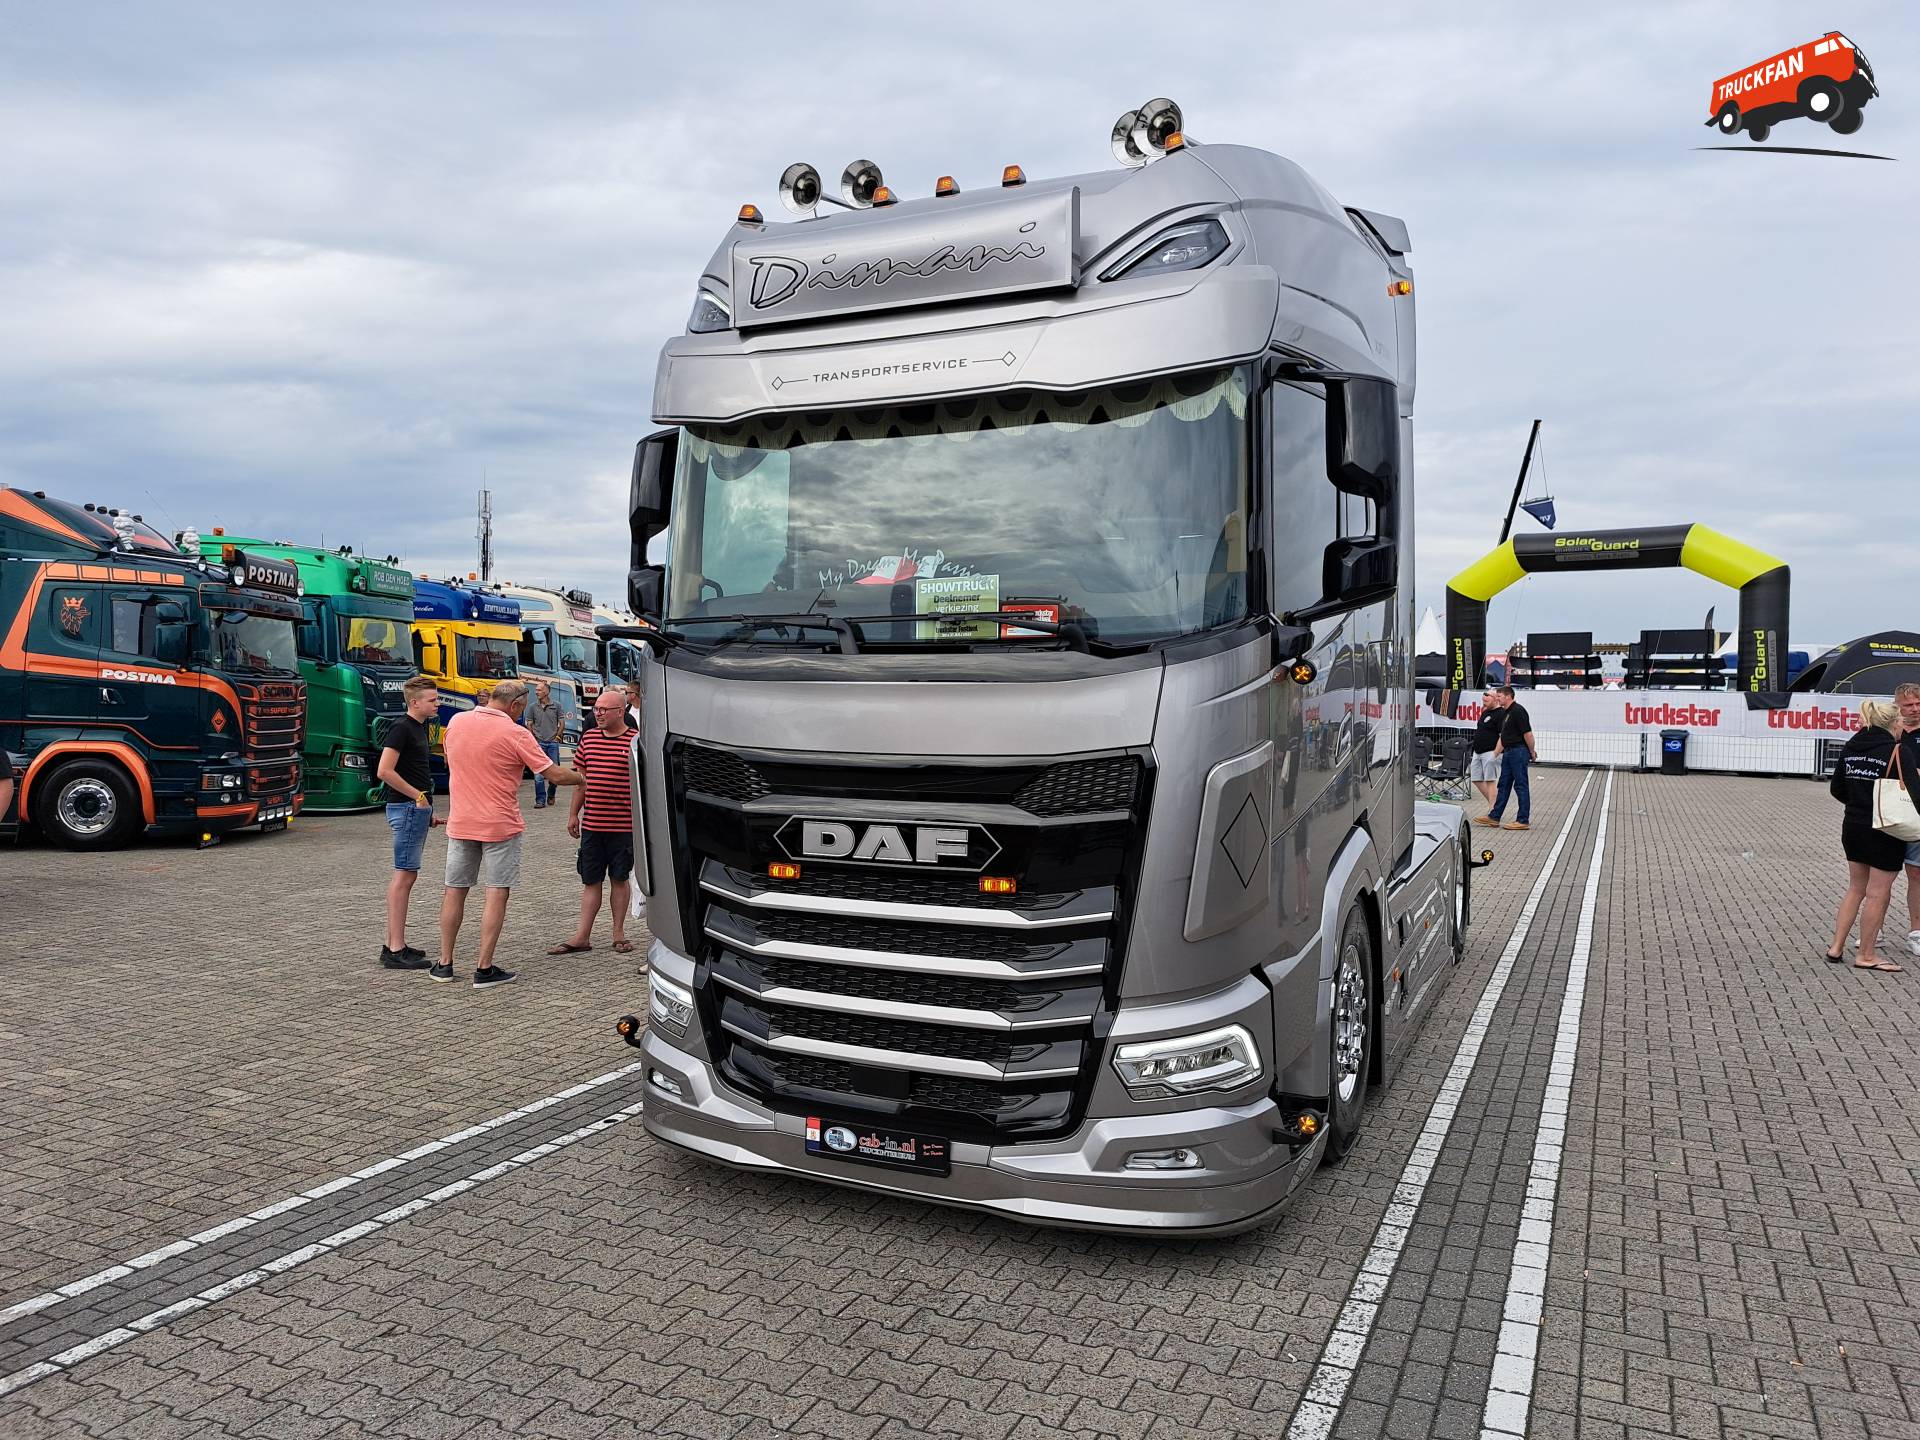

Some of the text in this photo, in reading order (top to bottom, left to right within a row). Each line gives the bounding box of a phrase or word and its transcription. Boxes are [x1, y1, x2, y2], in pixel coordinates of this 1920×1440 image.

[749, 222, 1045, 309] Dimani
[812, 358, 968, 383] TRANSPORTSERVICE
[249, 566, 296, 589] POSTMA
[818, 567, 844, 590] My
[920, 579, 994, 594] SHOWTRUCK
[935, 604, 979, 613] verkiezing
[102, 669, 177, 685] POSTMA
[383, 681, 404, 690] SCANI
[1625, 702, 1721, 726] truckstar
[1768, 706, 1861, 731] trucksta
[1845, 763, 1880, 777] Dimani
[803, 820, 969, 863] DAF
[858, 1132, 916, 1153] cab-in.nl
